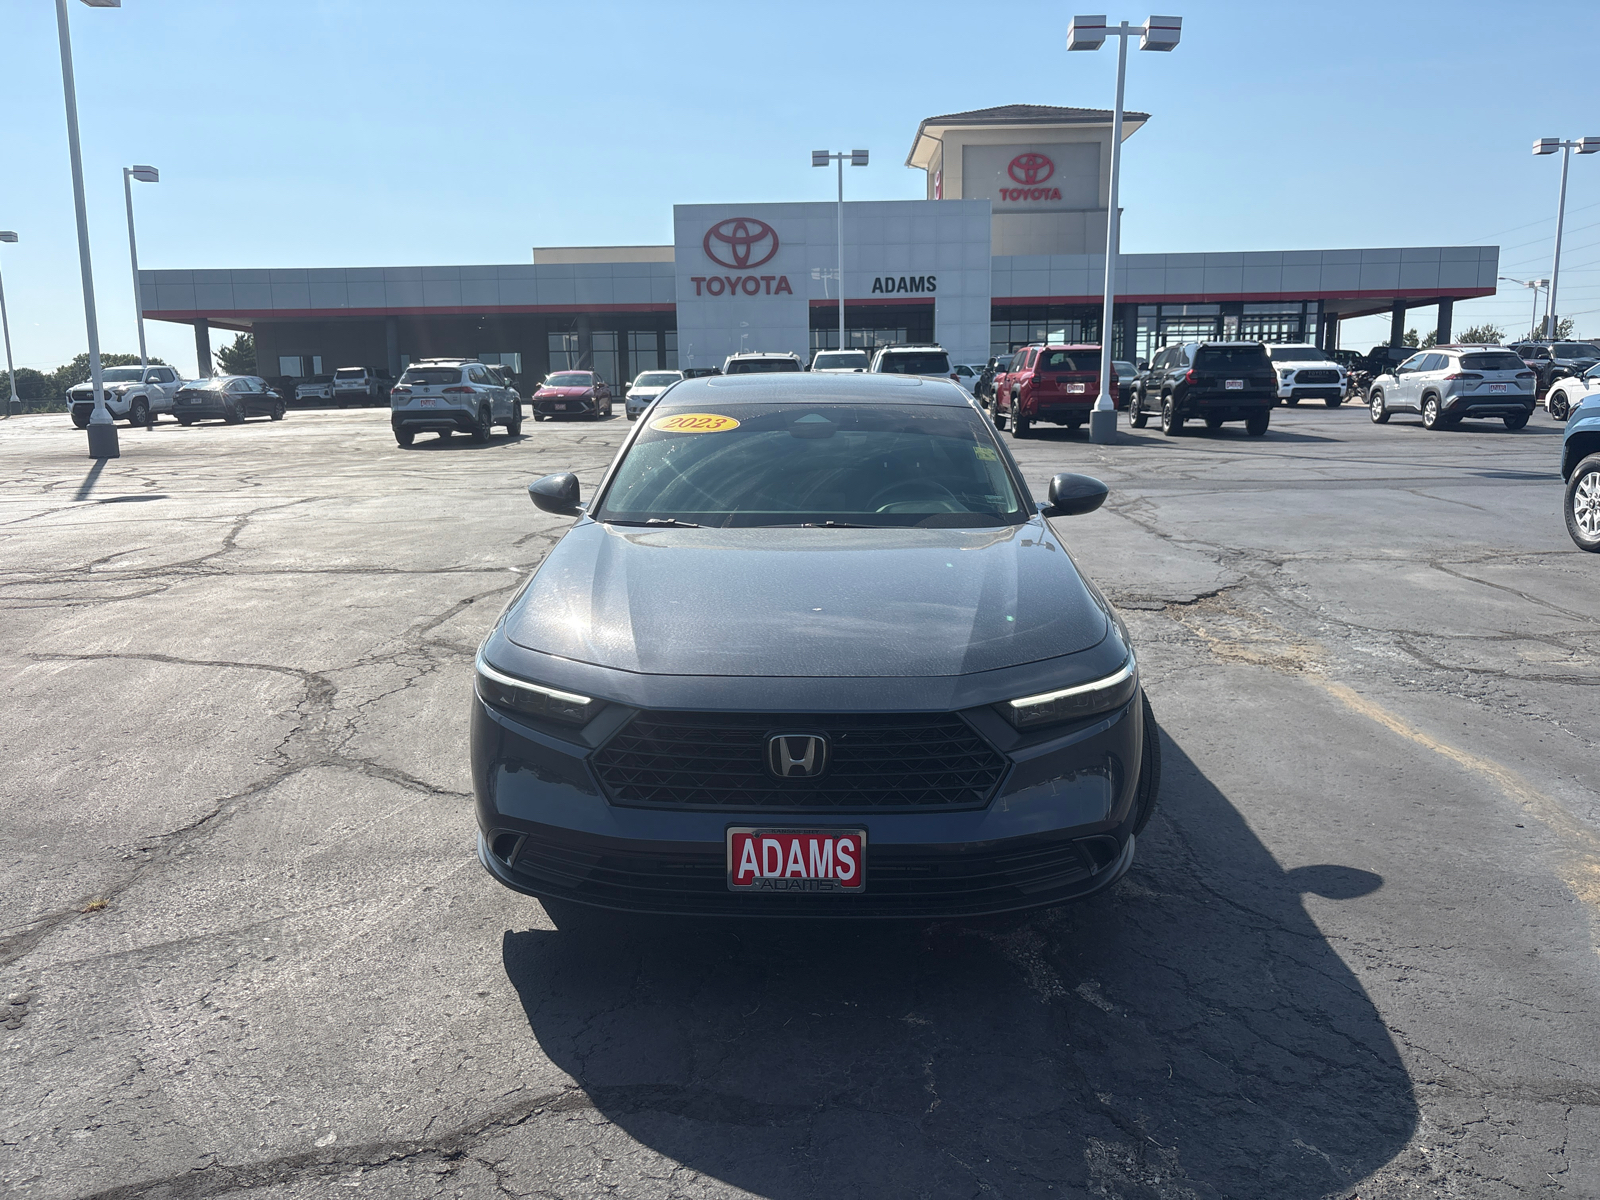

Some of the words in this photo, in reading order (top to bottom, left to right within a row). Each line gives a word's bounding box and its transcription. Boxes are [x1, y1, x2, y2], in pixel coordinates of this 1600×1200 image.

[999, 187, 1062, 201] TOYOTA
[690, 275, 793, 296] TOYOTA
[871, 275, 937, 294] ADAMS
[663, 417, 727, 429] 2023
[738, 838, 856, 880] ADAMS
[760, 879, 833, 891] ADAMS
